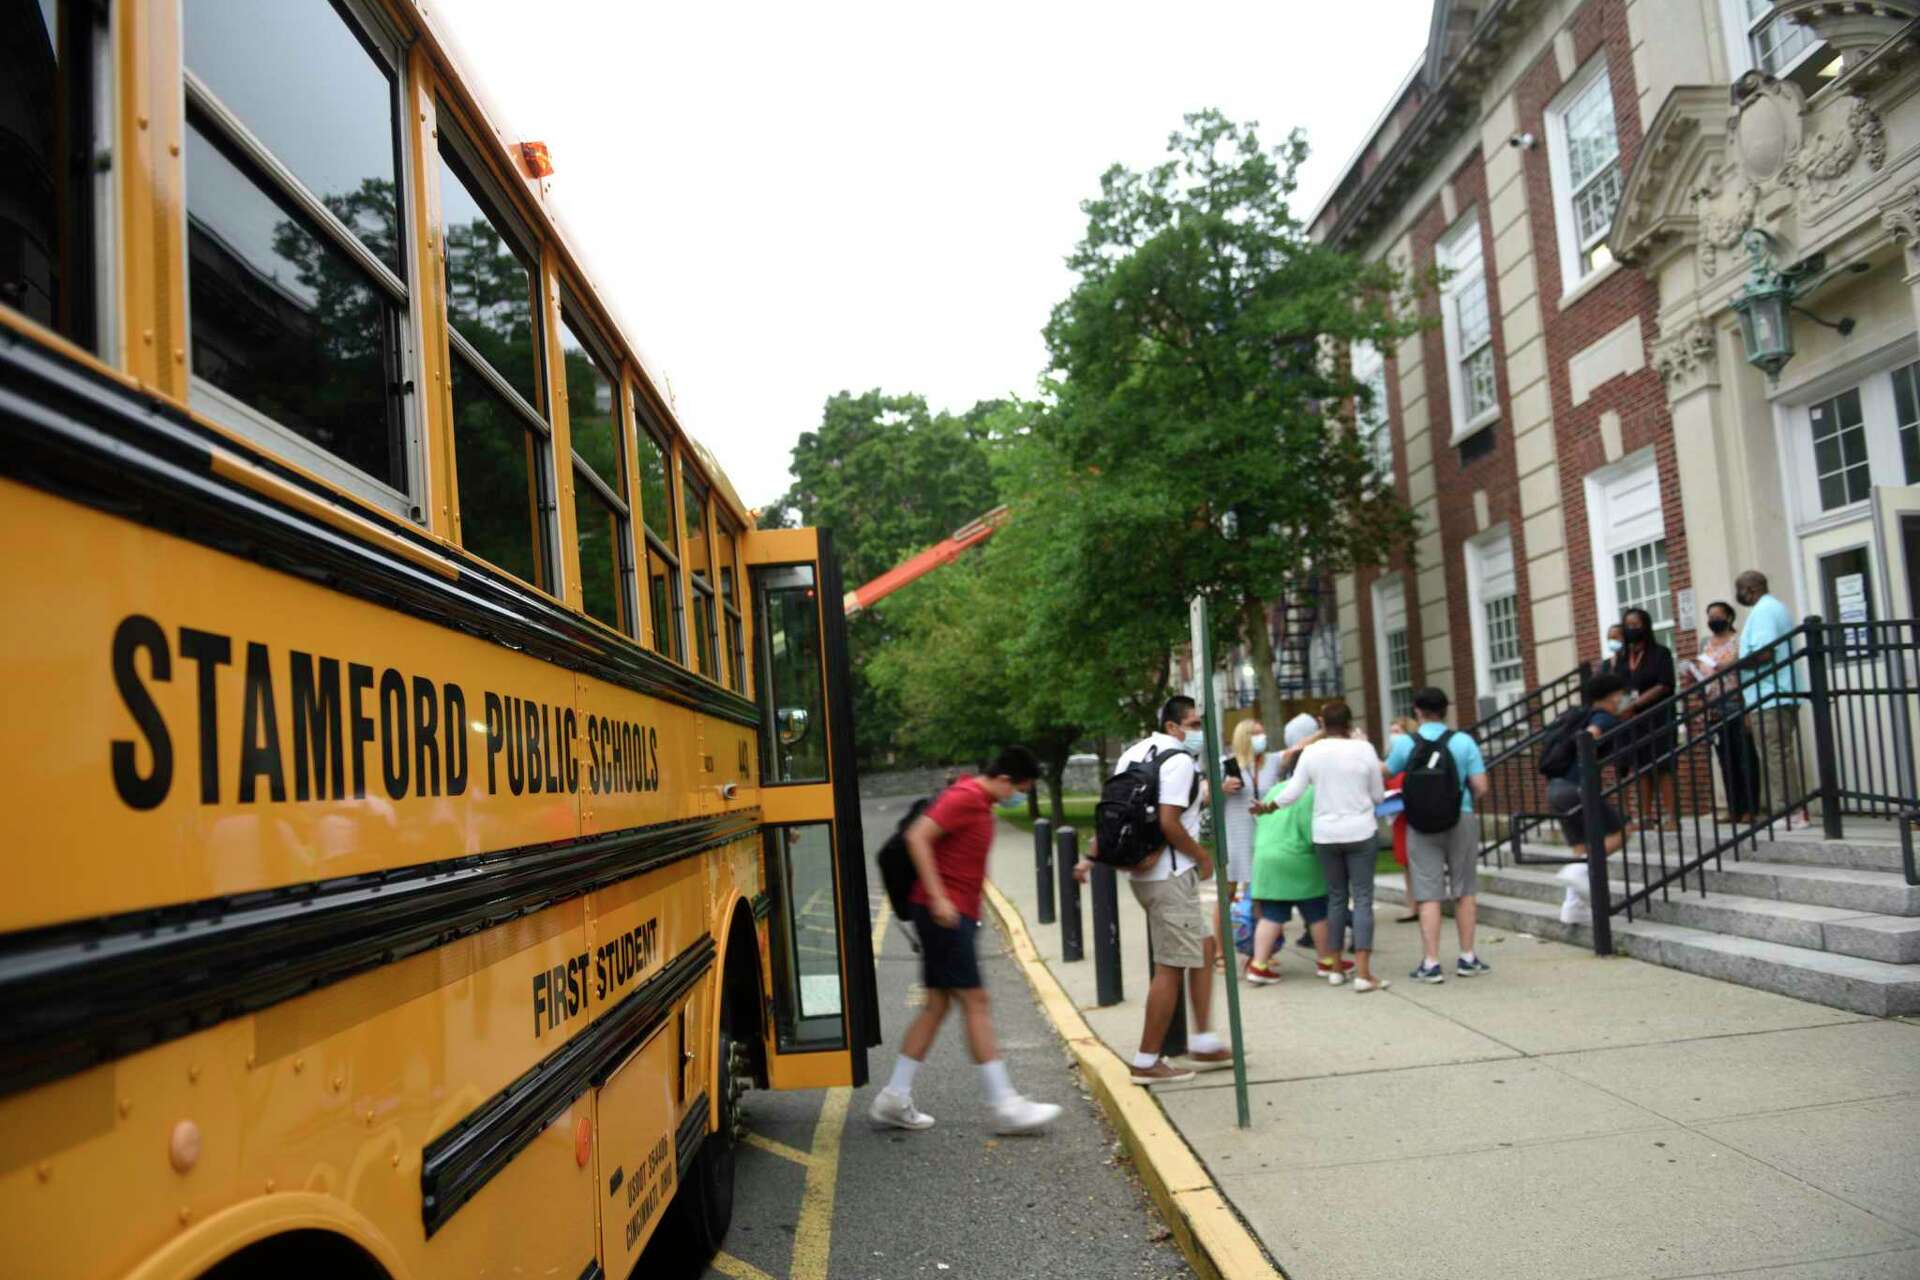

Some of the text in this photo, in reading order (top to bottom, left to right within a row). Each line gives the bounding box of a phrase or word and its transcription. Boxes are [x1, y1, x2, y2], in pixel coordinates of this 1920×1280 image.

[110, 613, 469, 812] STAMFORD
[484, 692, 580, 797] PUBLIC
[587, 714, 659, 795] SCHOOLS
[532, 918, 658, 1038] FIRST STUDENT
